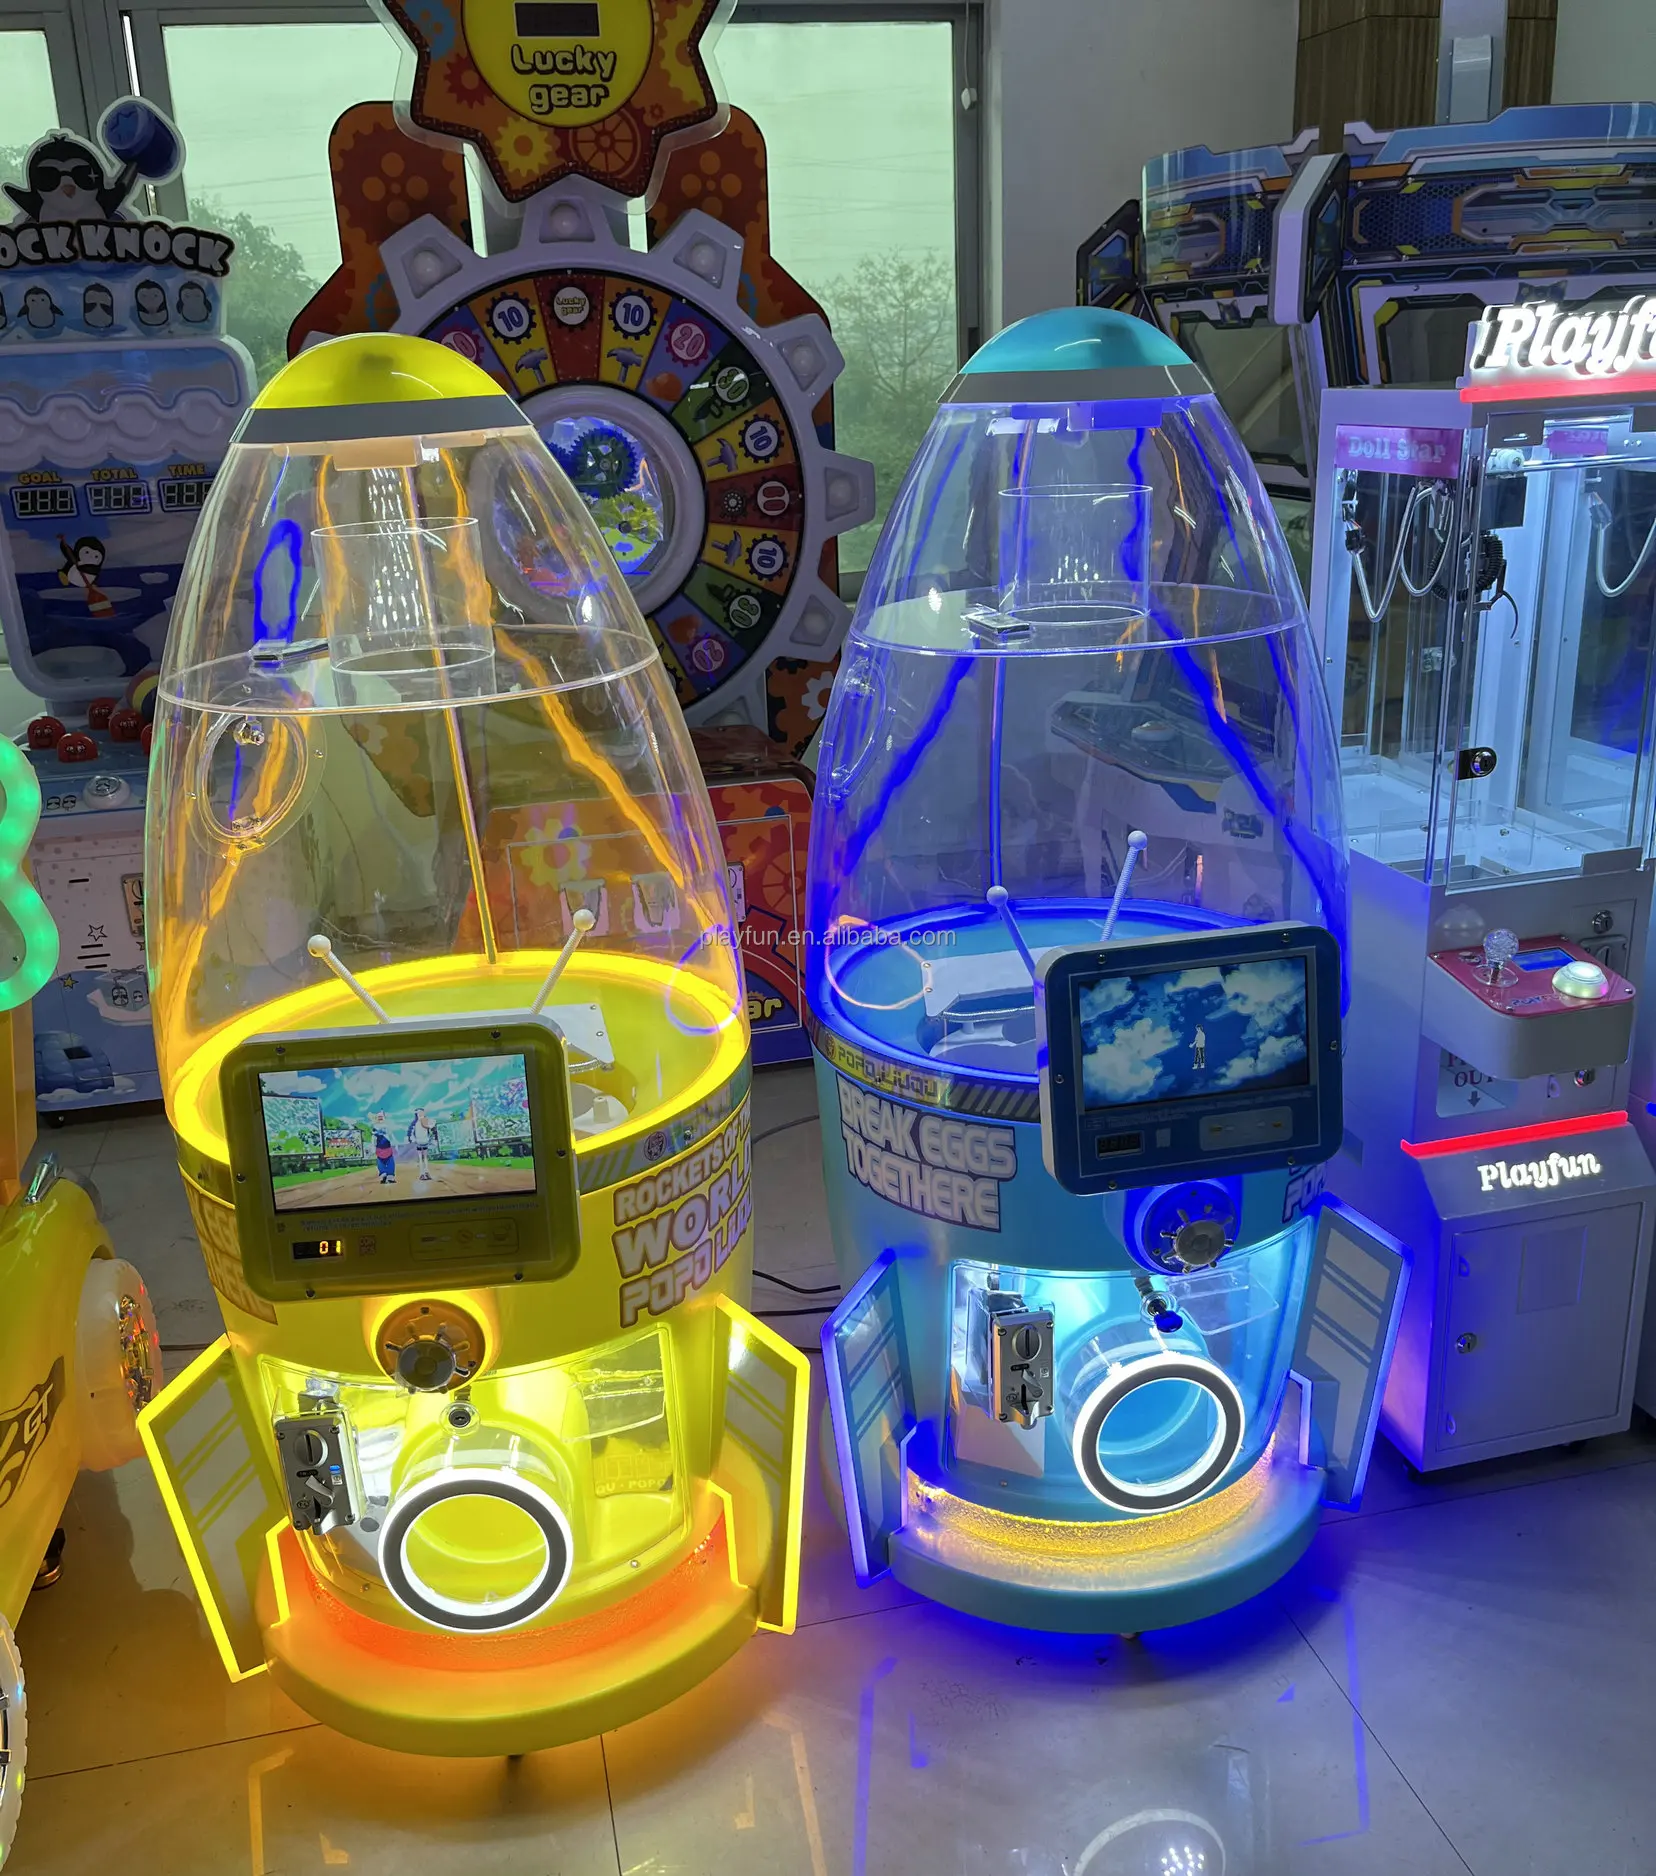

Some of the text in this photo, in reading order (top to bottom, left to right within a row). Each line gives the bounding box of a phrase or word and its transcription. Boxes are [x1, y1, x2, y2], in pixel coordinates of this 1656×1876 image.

[511, 44, 617, 82] Lucky
[529, 84, 610, 115] gear
[79, 222, 232, 276] KNOCK
[498, 306, 524, 332] 10
[622, 302, 644, 327] 10
[673, 325, 706, 357] 20
[1479, 295, 1656, 374] Playf
[750, 425, 772, 451] 10
[1348, 436, 1392, 460] Doll
[18, 471, 61, 485] GOAL
[91, 467, 138, 481] TOTAL
[168, 463, 206, 477] TIME
[758, 547, 777, 569] 10
[748, 998, 783, 1020] ar
[836, 1072, 1017, 1182] BREAK EGGS
[614, 1132, 725, 1227] ROCKETS
[723, 1119, 740, 1161] OF
[843, 1122, 1001, 1233] TOGETHERE
[1477, 1152, 1601, 1191] Playfun
[612, 1128, 752, 1280] WORLD
[319, 1239, 342, 1255] 01
[620, 1238, 713, 1329] POPO
[23, 1383, 54, 1445] GT
